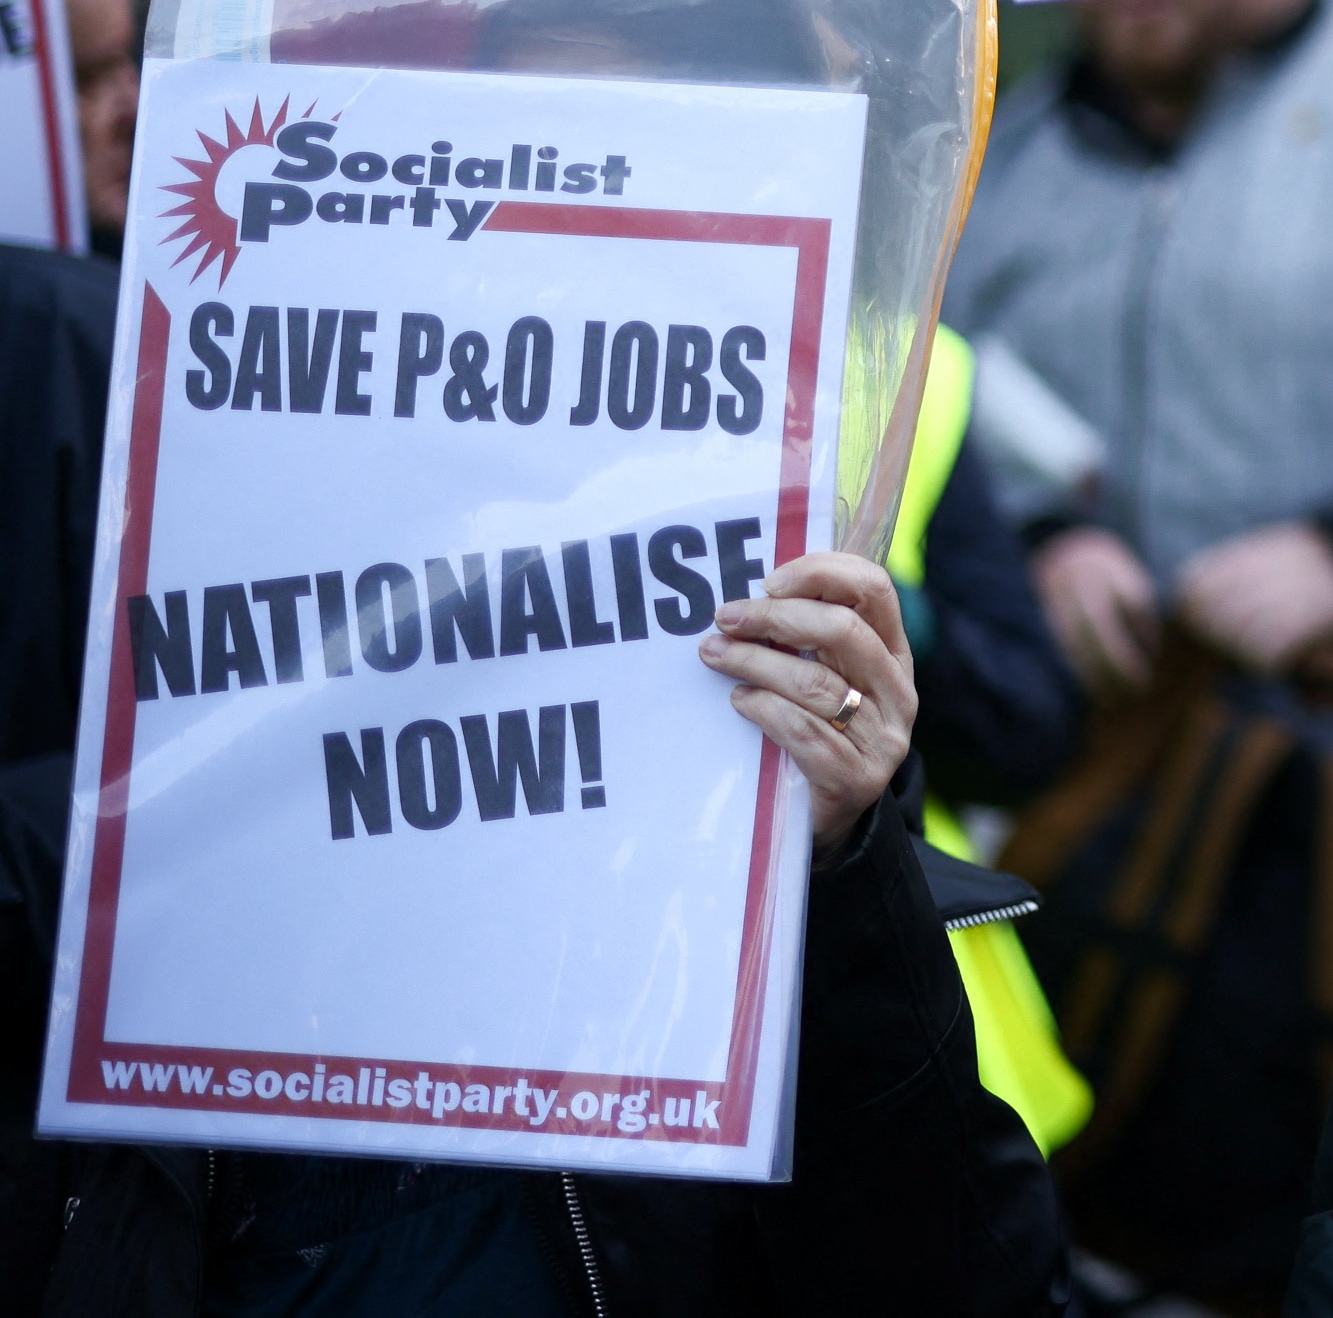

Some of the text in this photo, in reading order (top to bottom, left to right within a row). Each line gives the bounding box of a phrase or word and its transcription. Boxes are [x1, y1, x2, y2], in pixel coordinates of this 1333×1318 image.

[271, 120, 632, 196] Socialist
[185, 301, 767, 436] SAVE P&O JOBS
[127, 516, 765, 703] NATIONALISE
[322, 700, 608, 842] NOW!
[101, 1056, 721, 1133] www.socialistparty.org.uk
